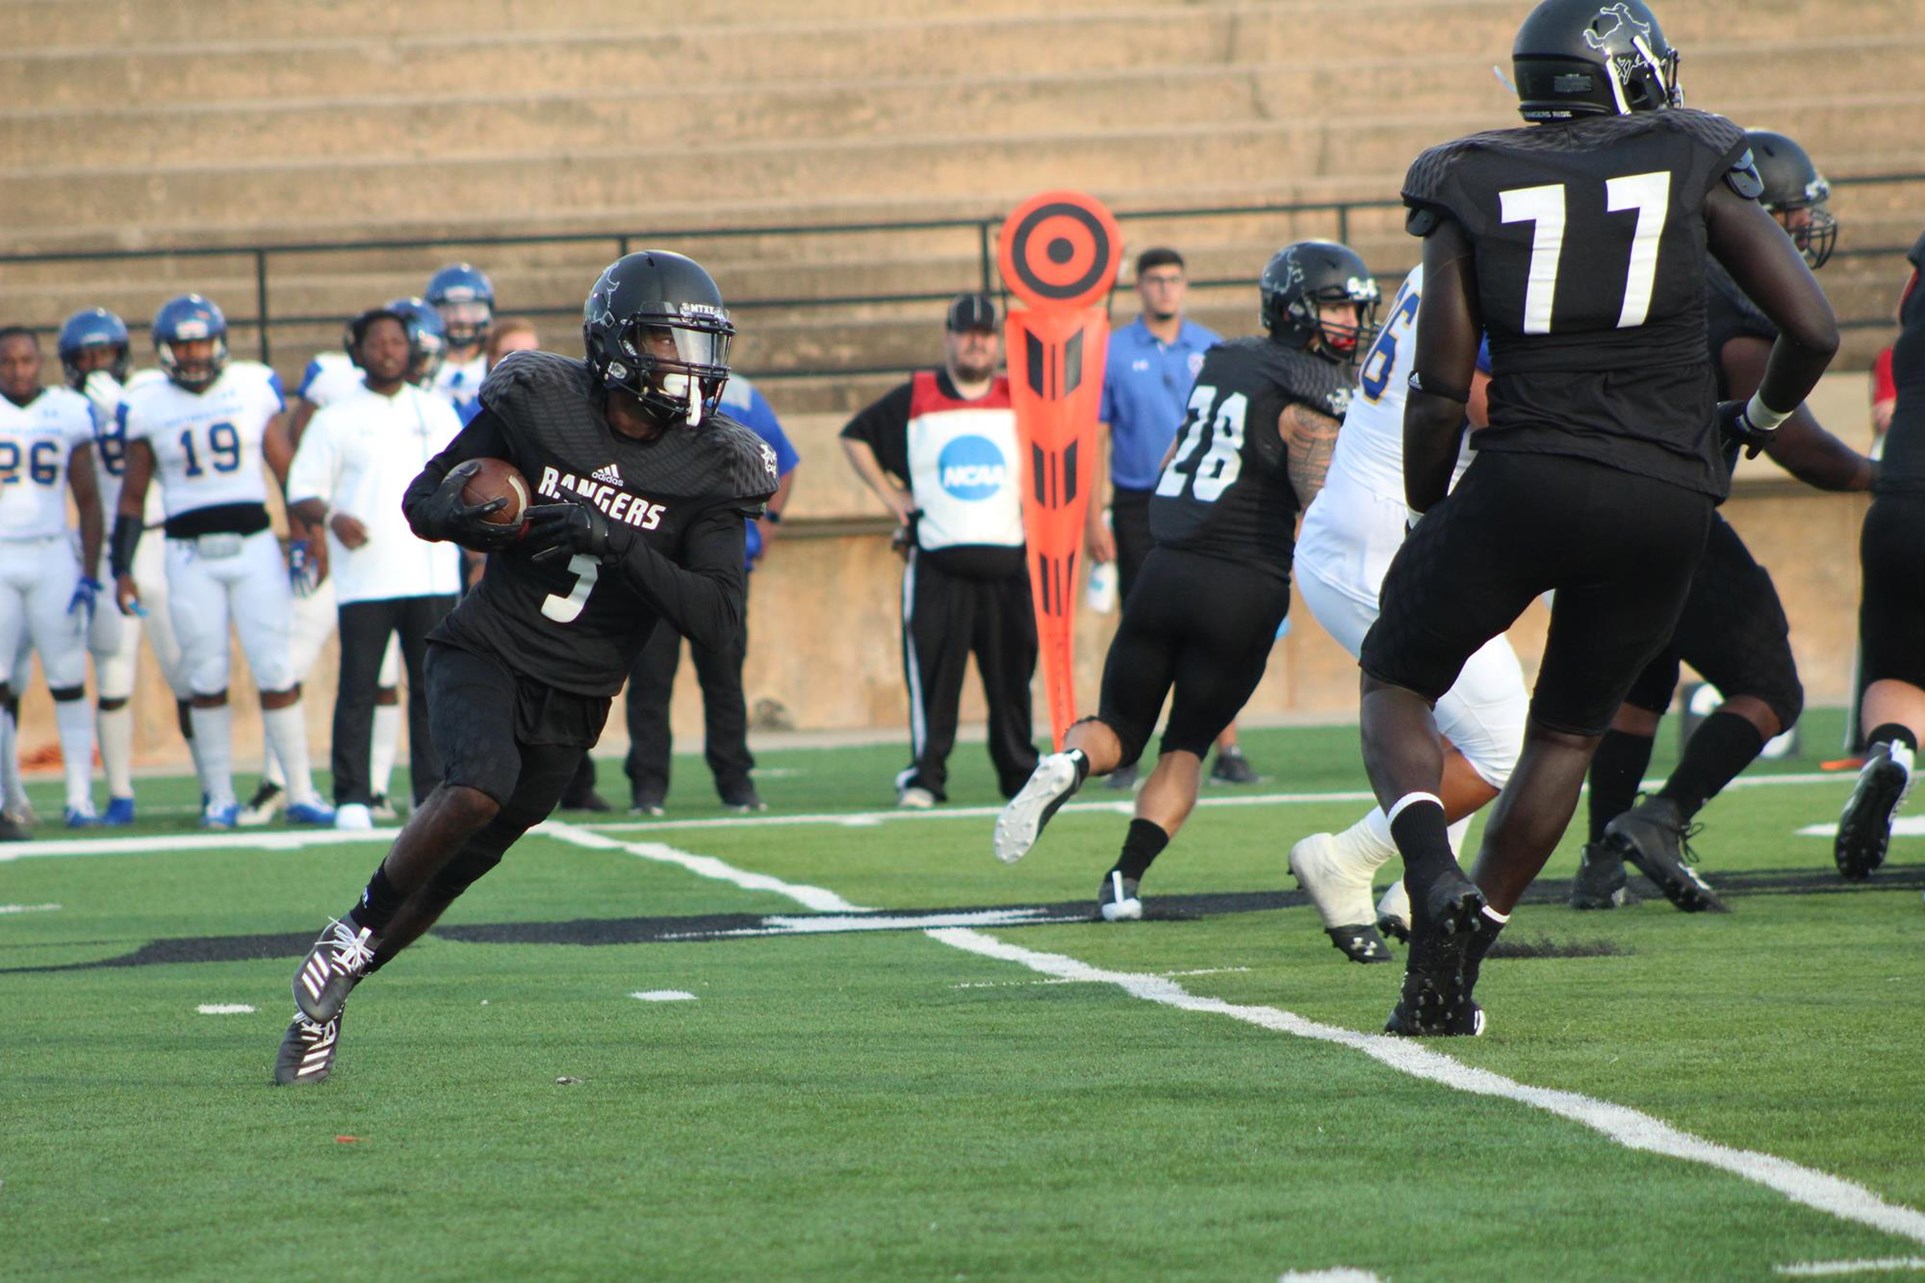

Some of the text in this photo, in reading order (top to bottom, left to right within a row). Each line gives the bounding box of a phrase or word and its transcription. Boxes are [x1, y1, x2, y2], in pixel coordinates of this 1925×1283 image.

[1498, 171, 1671, 334] 77
[690, 303, 715, 315] MTXE
[0, 441, 58, 485] 26
[180, 422, 240, 477] 19
[1155, 385, 1248, 502] 28
[538, 466, 667, 530] RANGERS
[591, 471, 624, 487] adidas
[944, 464, 1006, 488] NCAA
